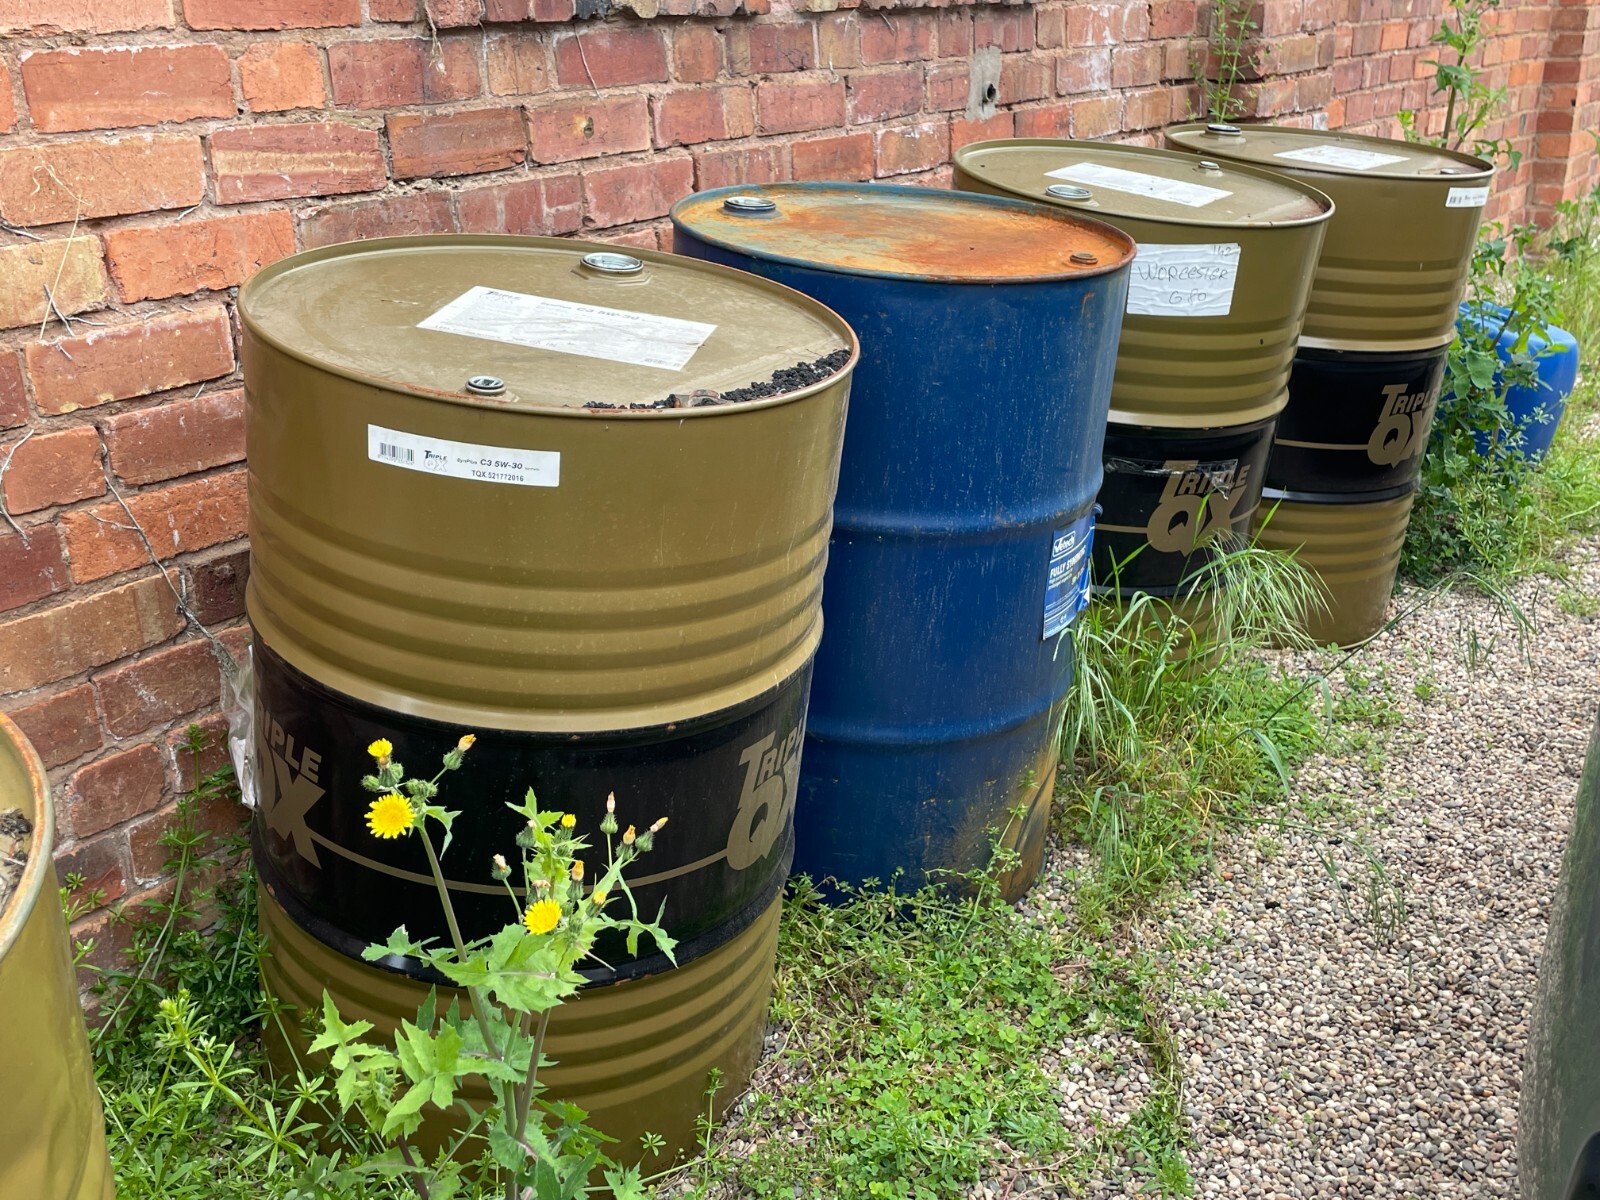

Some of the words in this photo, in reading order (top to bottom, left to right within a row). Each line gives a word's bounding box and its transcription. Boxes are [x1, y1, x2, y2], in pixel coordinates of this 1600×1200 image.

[424, 449, 448, 461] TRIPLE
[480, 458, 493, 468] C3
[494, 460, 523, 471] 5W-30
